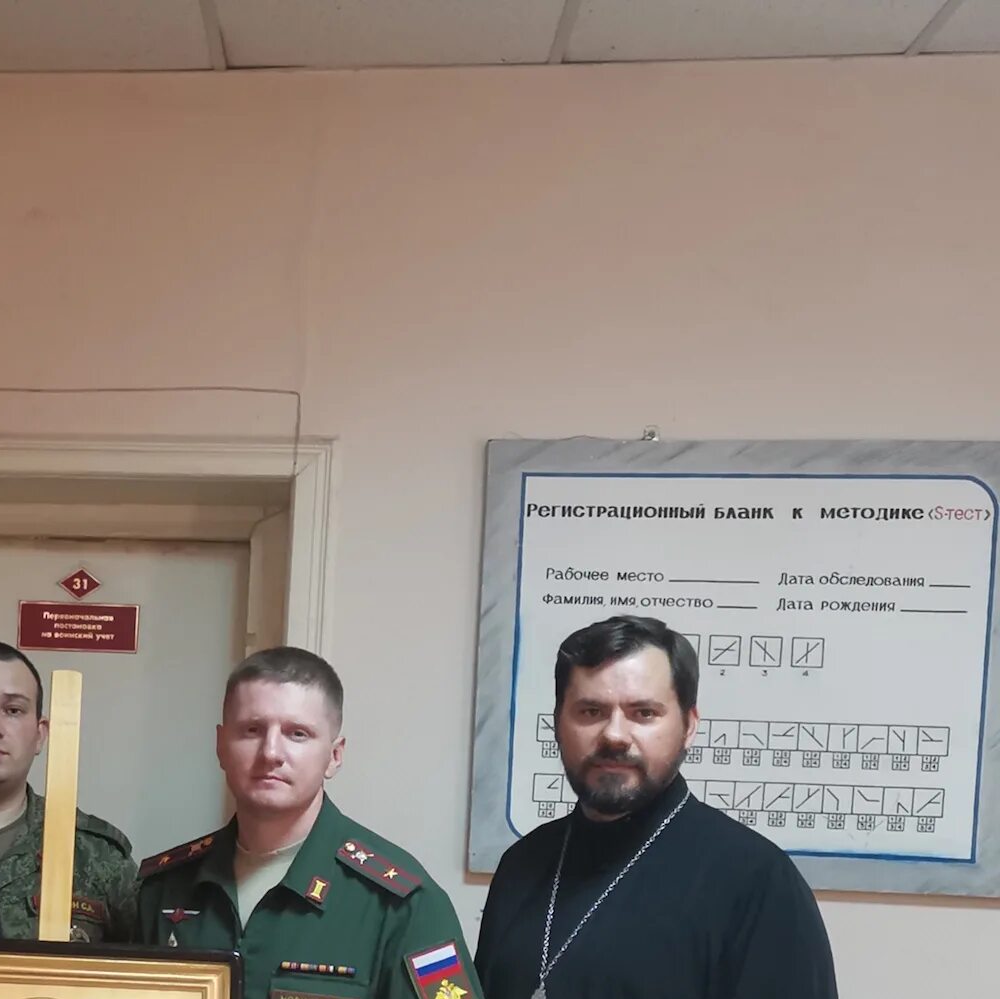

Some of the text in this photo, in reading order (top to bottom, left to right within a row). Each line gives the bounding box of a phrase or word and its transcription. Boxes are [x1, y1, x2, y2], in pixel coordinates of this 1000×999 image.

[526, 503, 706, 520] Регистрационный
[820, 506, 925, 521] методике
[545, 567, 665, 582] Рабочее место
[778, 571, 925, 588] Дата обследования
[72, 578, 88, 590] 31
[640, 596, 714, 609] отчество
[776, 598, 896, 613] Дата рождения
